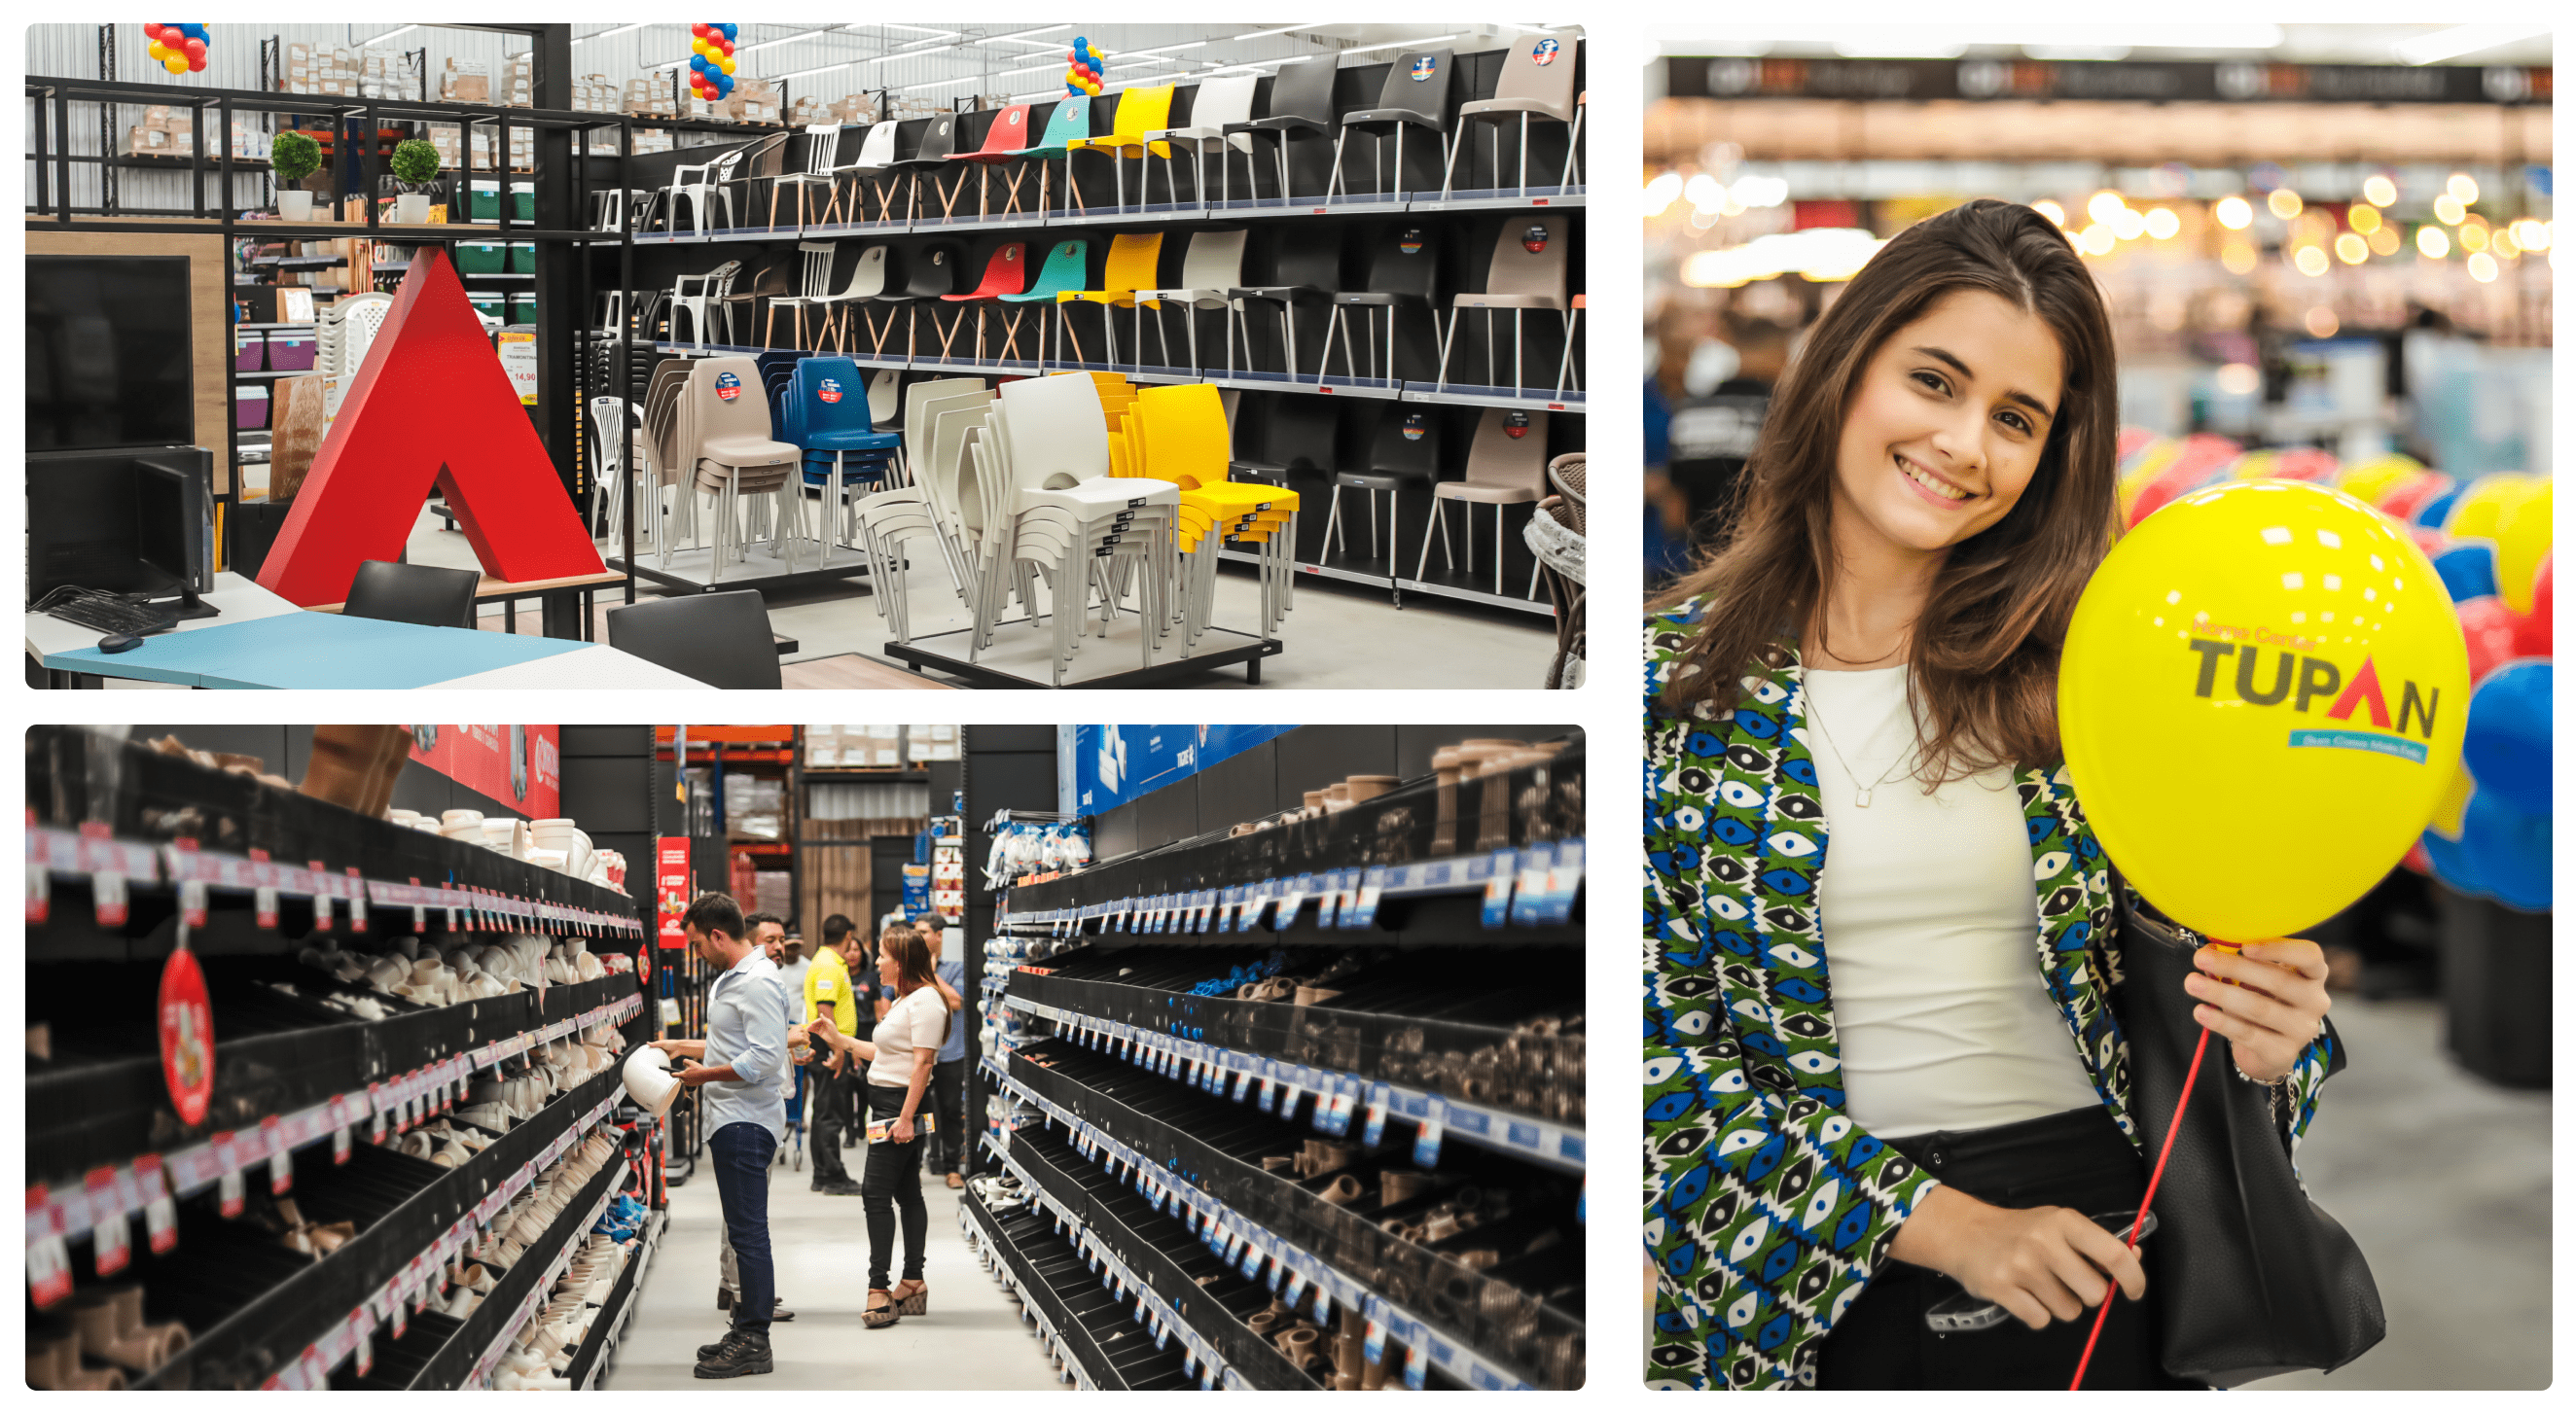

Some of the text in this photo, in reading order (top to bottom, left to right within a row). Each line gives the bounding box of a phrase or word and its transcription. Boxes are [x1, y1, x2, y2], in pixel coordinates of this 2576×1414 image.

[515, 372, 536, 381] 14,90
[2191, 616, 2319, 652] Home Center
[2188, 637, 2441, 740] TUPAN
[1177, 748, 1190, 768] TIGRE
